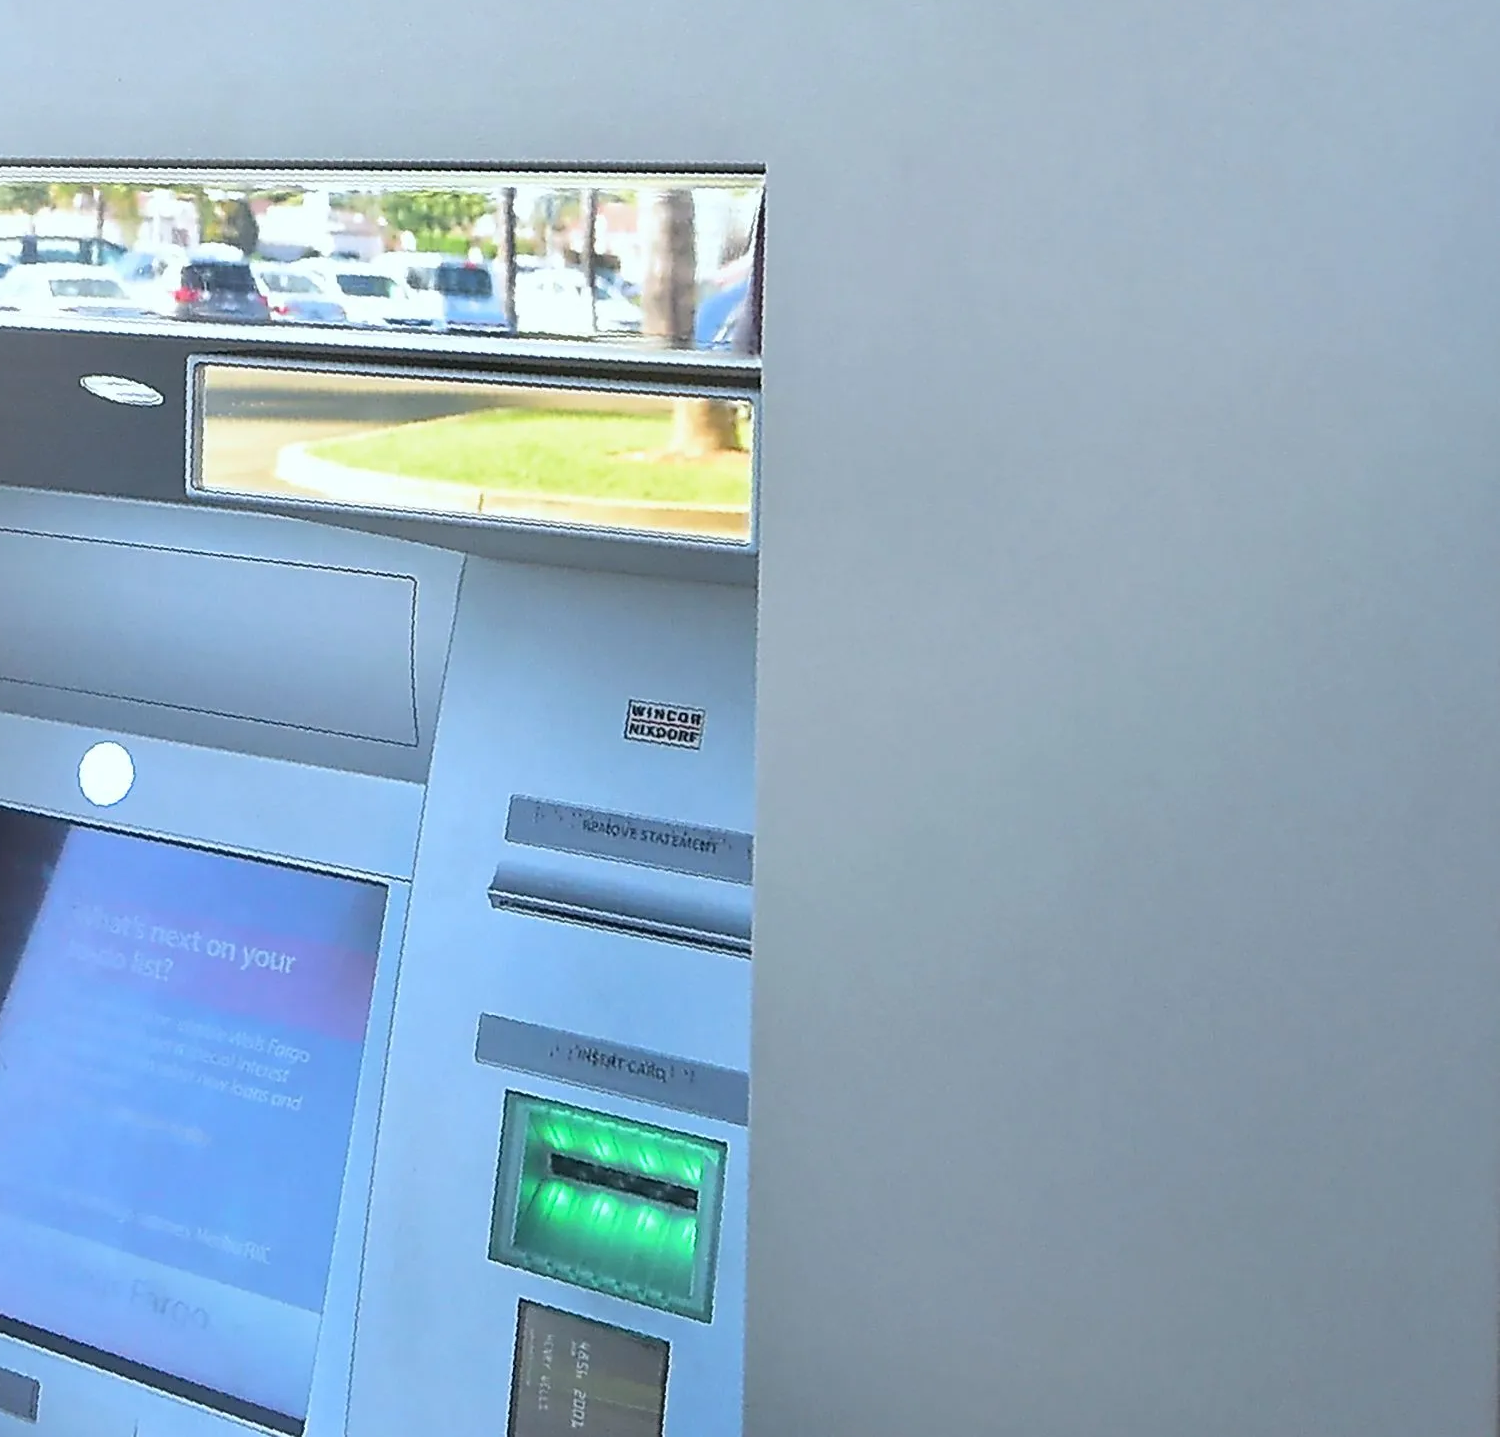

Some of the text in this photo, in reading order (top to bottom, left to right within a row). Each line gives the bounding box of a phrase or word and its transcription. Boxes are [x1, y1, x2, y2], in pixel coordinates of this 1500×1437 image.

[631, 705, 702, 726] WINCOR
[628, 723, 700, 743] NIXDORF
[582, 817, 720, 856] REMOVE STATEMENT
[150, 923, 203, 954] next
[206, 937, 236, 962] on
[239, 945, 297, 975] your
[266, 1037, 311, 1065] Fargo
